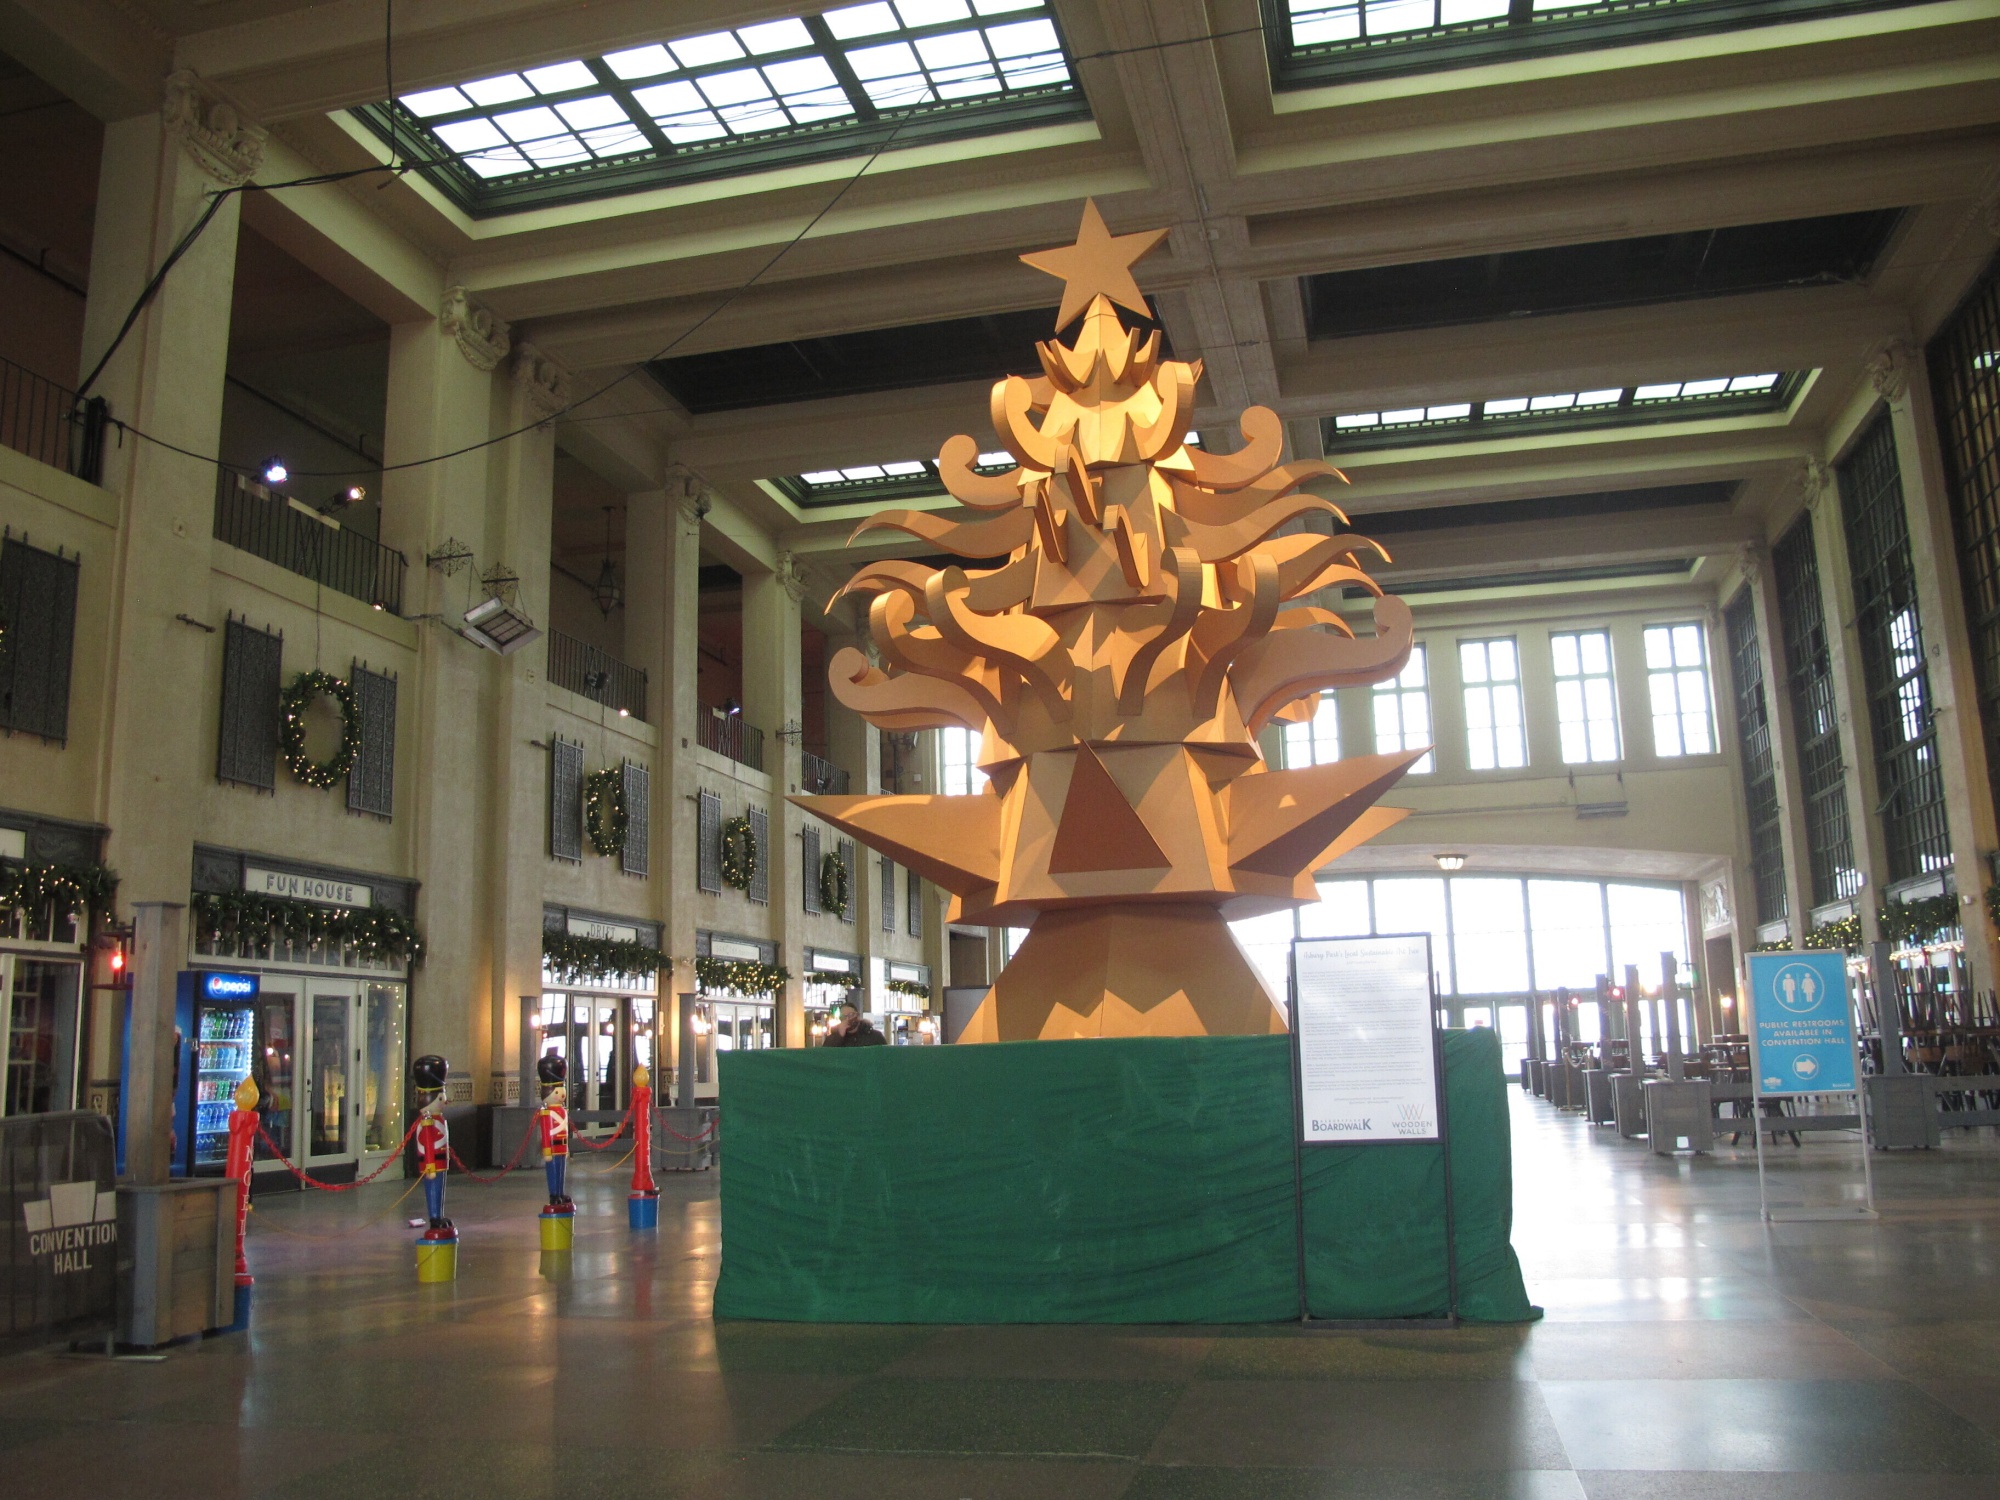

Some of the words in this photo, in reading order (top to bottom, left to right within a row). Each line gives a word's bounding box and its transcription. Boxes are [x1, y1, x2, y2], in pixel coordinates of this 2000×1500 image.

[266, 873, 298, 895] FUN
[303, 880, 353, 902] HOUSE
[590, 923, 616, 939] DRIFT
[223, 981, 251, 994] pepsi
[1759, 1021, 1789, 1029] PUBLIC
[1792, 1019, 1844, 1028] RESTROOMS
[1773, 1029, 1819, 1037] AVAILABLE
[1822, 1028, 1832, 1036] IN
[1761, 1038, 1821, 1047] CONVENTION
[1824, 1037, 1846, 1045] HALL
[1398, 1127, 1427, 1135] WALLS
[30, 1222, 117, 1256] CONVENTION
[54, 1249, 92, 1275] HALL
